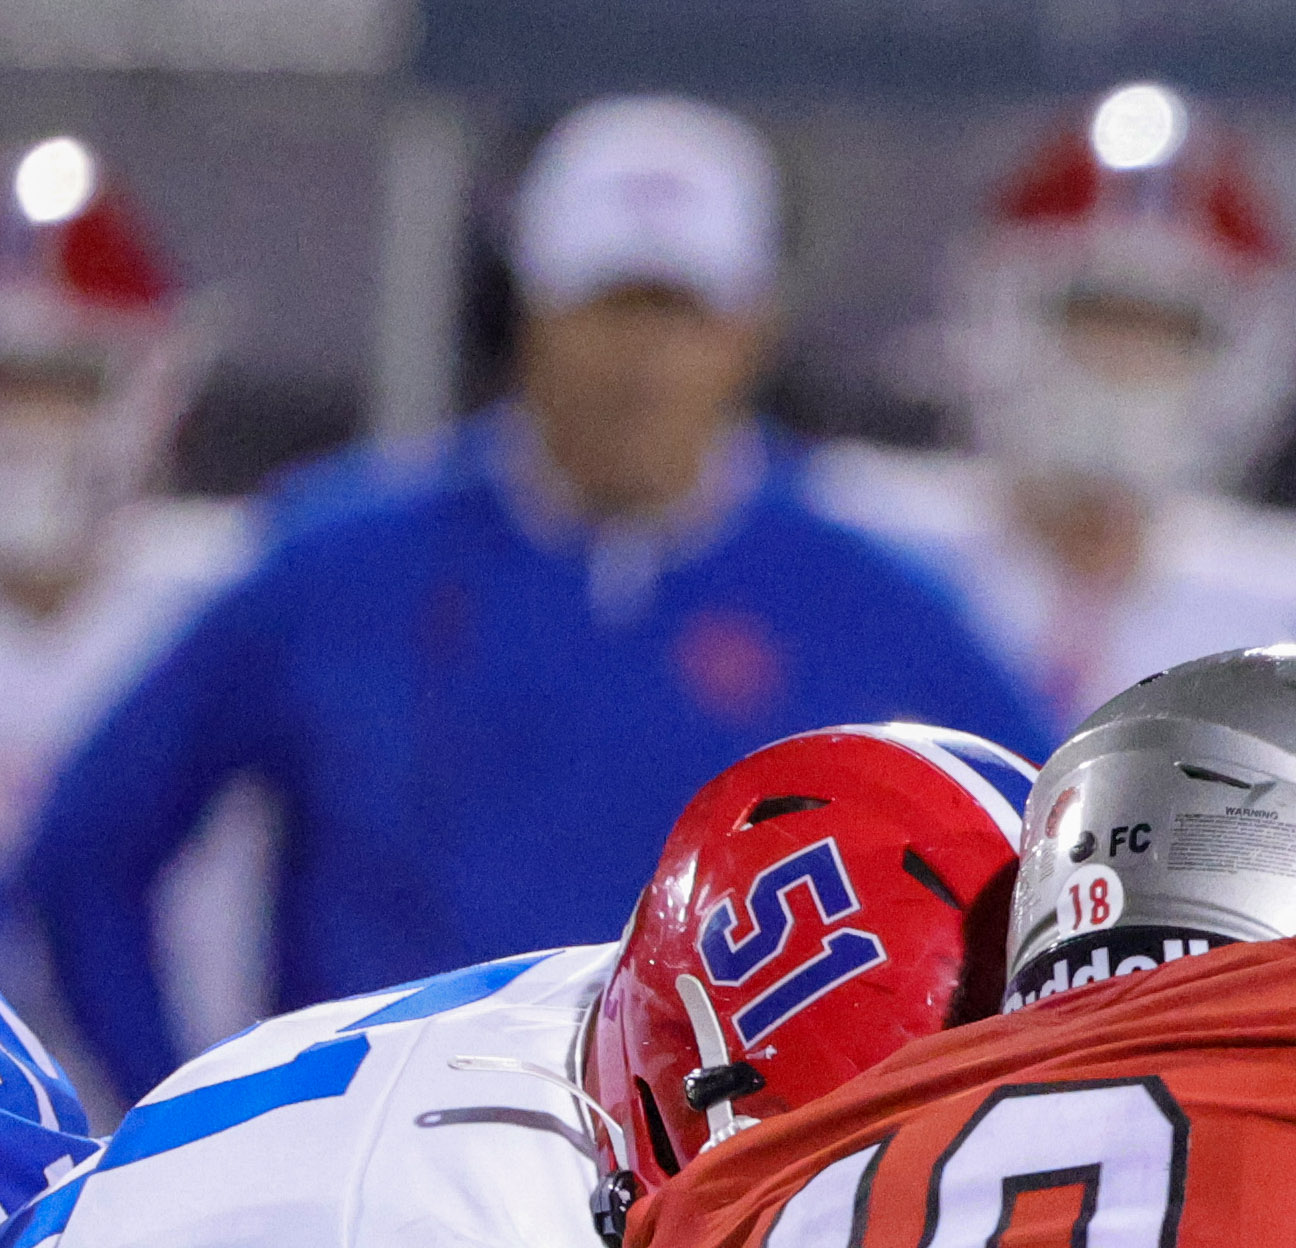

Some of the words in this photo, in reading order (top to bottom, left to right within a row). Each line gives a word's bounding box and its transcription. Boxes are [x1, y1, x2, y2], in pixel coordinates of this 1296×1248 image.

[1109, 823, 1153, 858] FC
[1068, 877, 1111, 931] 18
[700, 836, 888, 1050] 51
